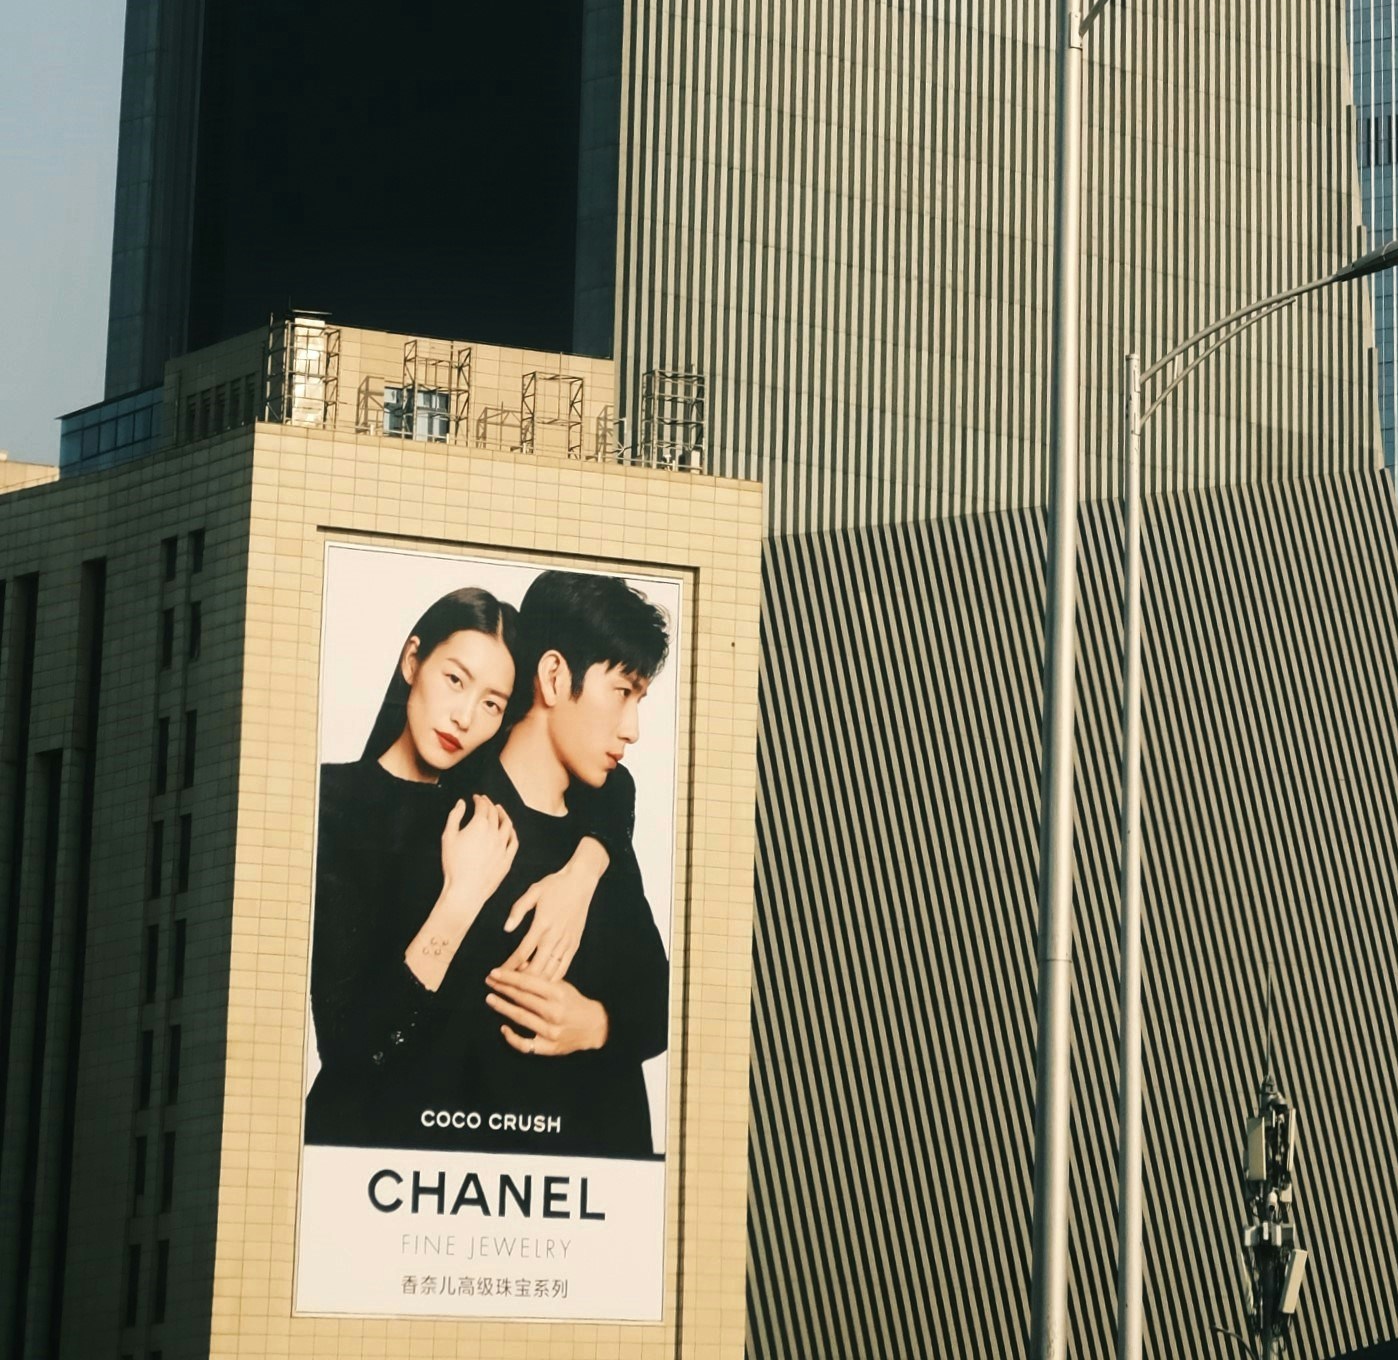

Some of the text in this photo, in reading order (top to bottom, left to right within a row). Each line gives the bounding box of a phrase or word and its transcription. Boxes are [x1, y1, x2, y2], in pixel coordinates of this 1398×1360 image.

[420, 1109, 561, 1133] COCO CRUSH
[367, 1168, 606, 1221] CHANEL
[402, 1234, 571, 1260] FINE JEWELRY
[402, 1275, 568, 1299] 香奈儿高级珠宝系列
